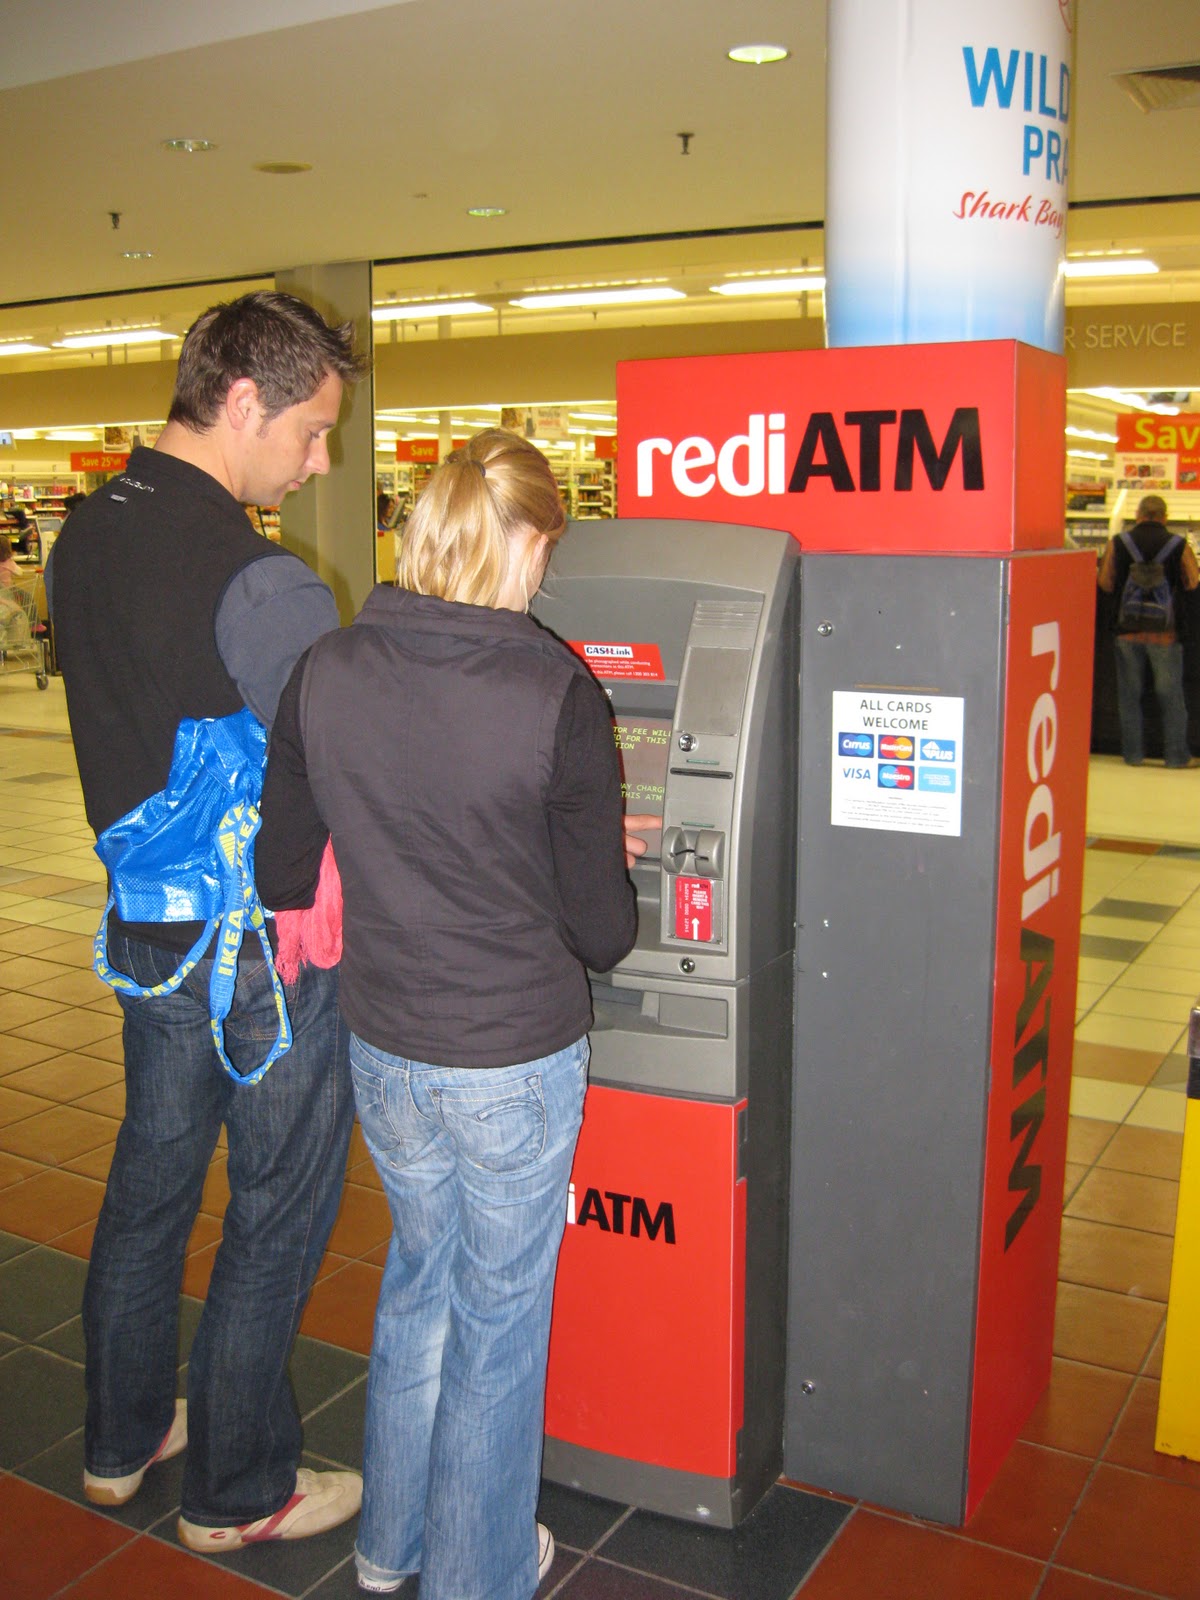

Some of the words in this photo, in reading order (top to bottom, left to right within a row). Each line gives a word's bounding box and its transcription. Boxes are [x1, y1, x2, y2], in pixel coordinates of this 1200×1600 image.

[962, 46, 1070, 124] WILD
[953, 191, 1032, 223] Shark
[1034, 199, 1065, 239] Bay
[1084, 322, 1186, 349] SERVICE
[410, 444, 434, 456] Save
[81, 456, 99, 467] Save
[860, 699, 883, 710] ALL
[887, 701, 932, 713] CARDS
[863, 716, 928, 730] WELCOME
[646, 737, 667, 745] THIS
[843, 768, 871, 780] VISA
[621, 791, 641, 799] THIS
[645, 793, 662, 801] ATM
[217, 908, 244, 977] IKEA
[142, 959, 196, 998] IKEA
